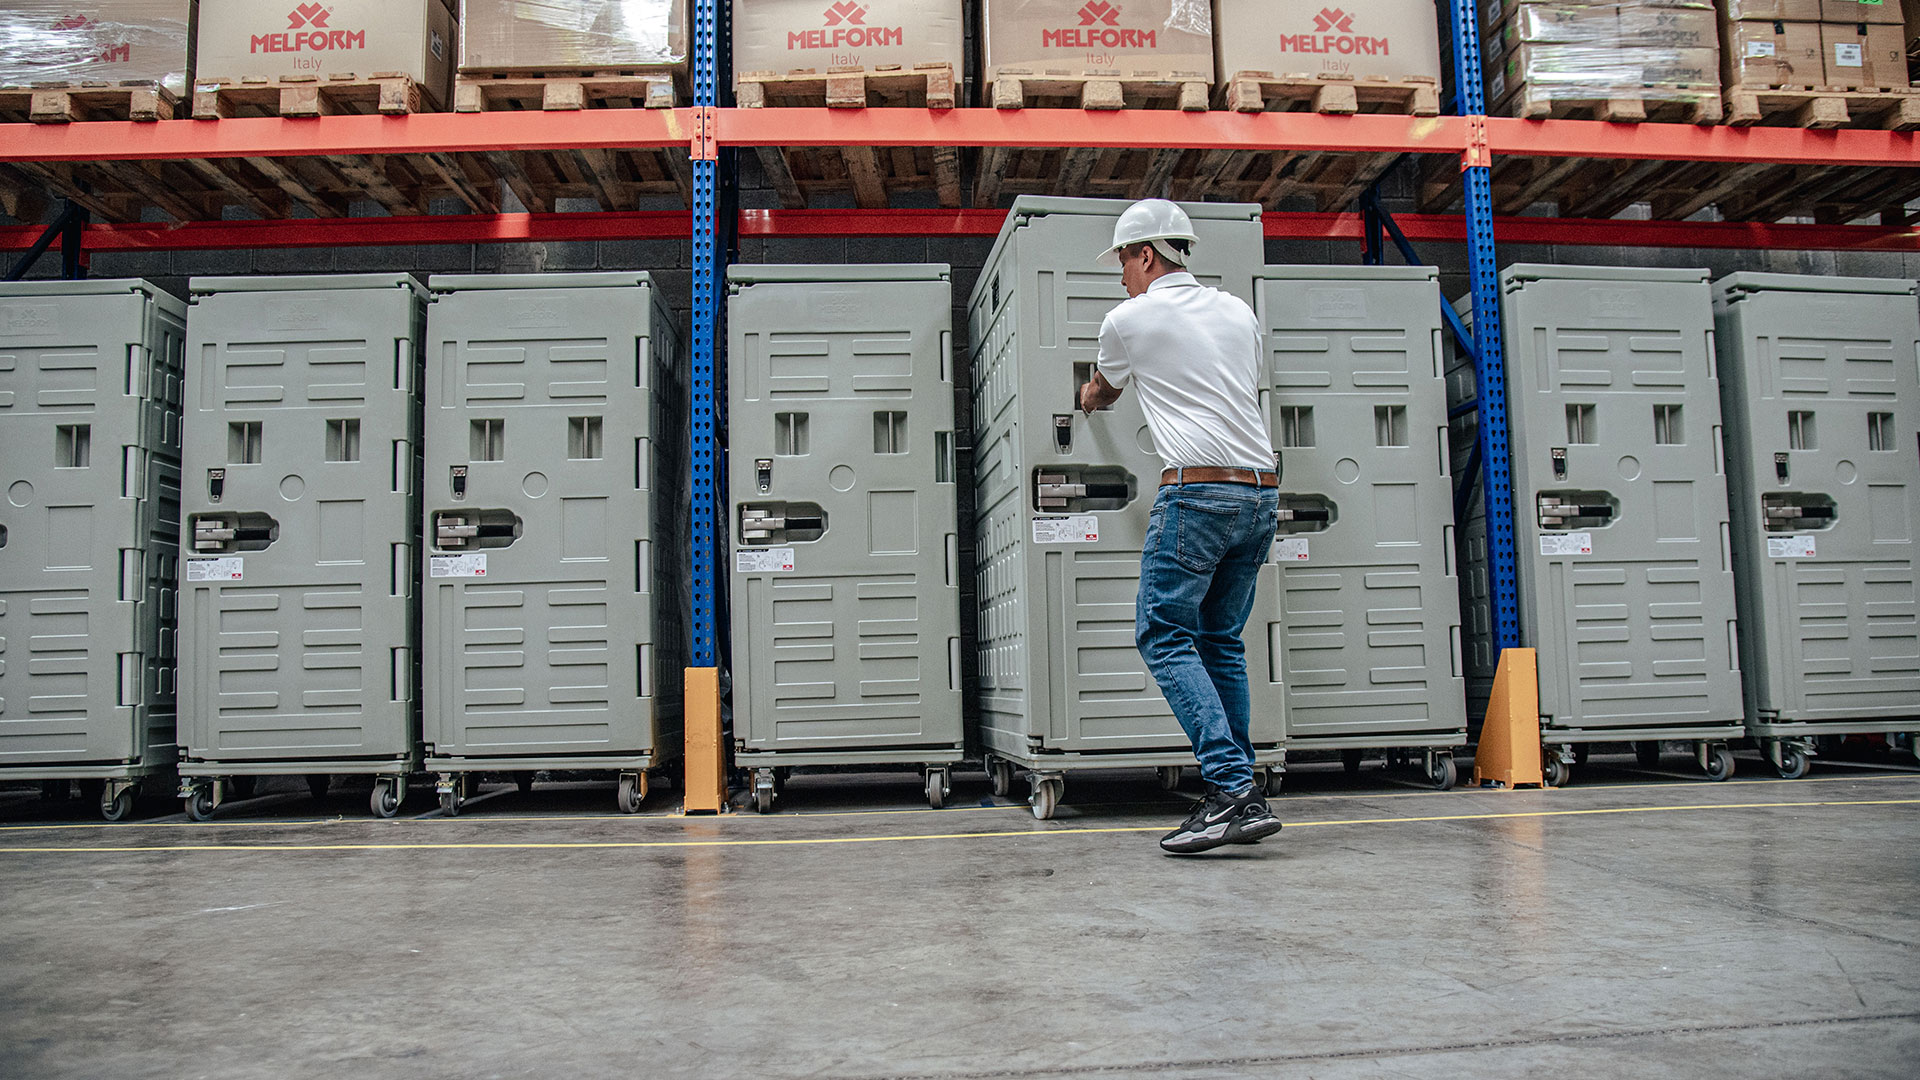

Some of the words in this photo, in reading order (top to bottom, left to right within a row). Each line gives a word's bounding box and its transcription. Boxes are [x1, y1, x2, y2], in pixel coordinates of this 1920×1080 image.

[250, 29, 366, 54] MELFORM
[787, 27, 903, 50] MELFORM
[1042, 28, 1156, 49] MELFORM
[1280, 34, 1389, 55] MELFORM
[293, 56, 323, 72] Italy
[831, 52, 862, 67] Italy
[1085, 51, 1116, 67] Italy
[1322, 58, 1350, 73] Italy
